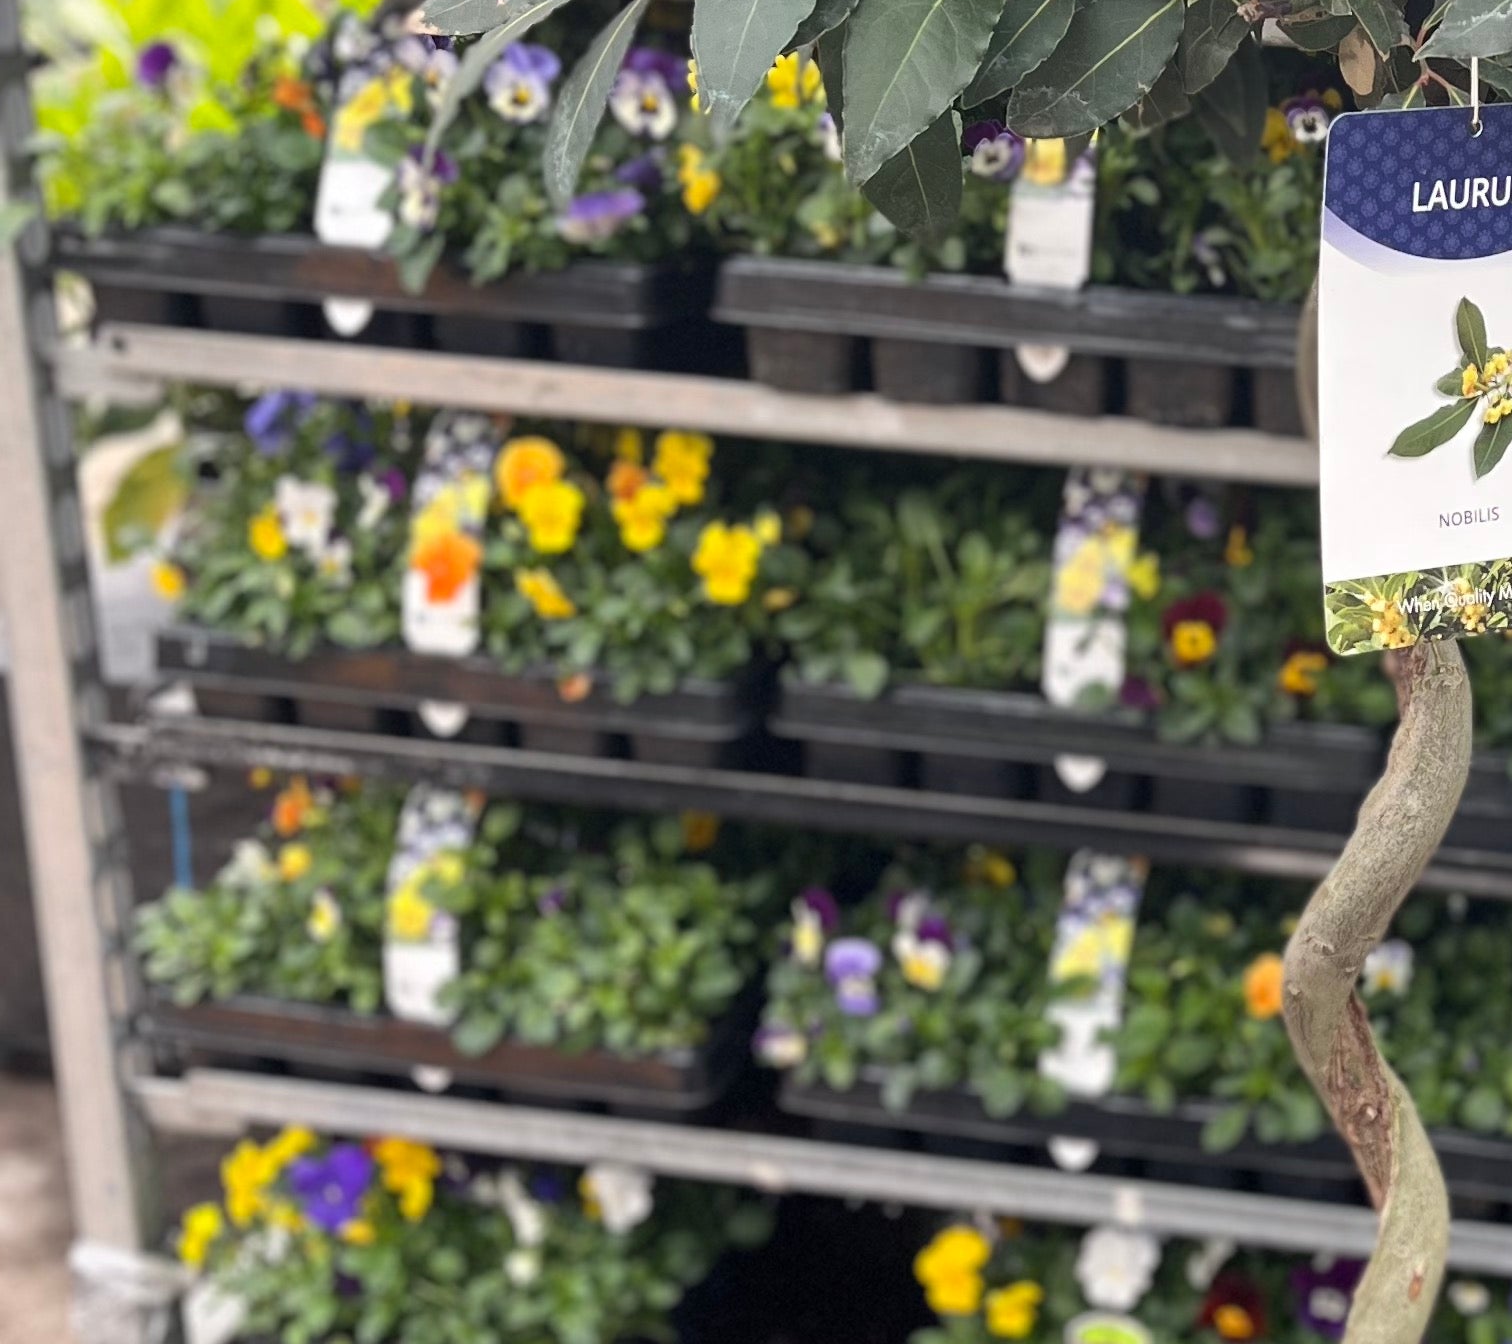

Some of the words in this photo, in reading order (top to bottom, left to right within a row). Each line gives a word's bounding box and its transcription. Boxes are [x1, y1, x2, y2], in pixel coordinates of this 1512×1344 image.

[1439, 506, 1500, 528] NOBILIS
[1397, 595, 1440, 614] When
[1444, 587, 1495, 608] Quality
